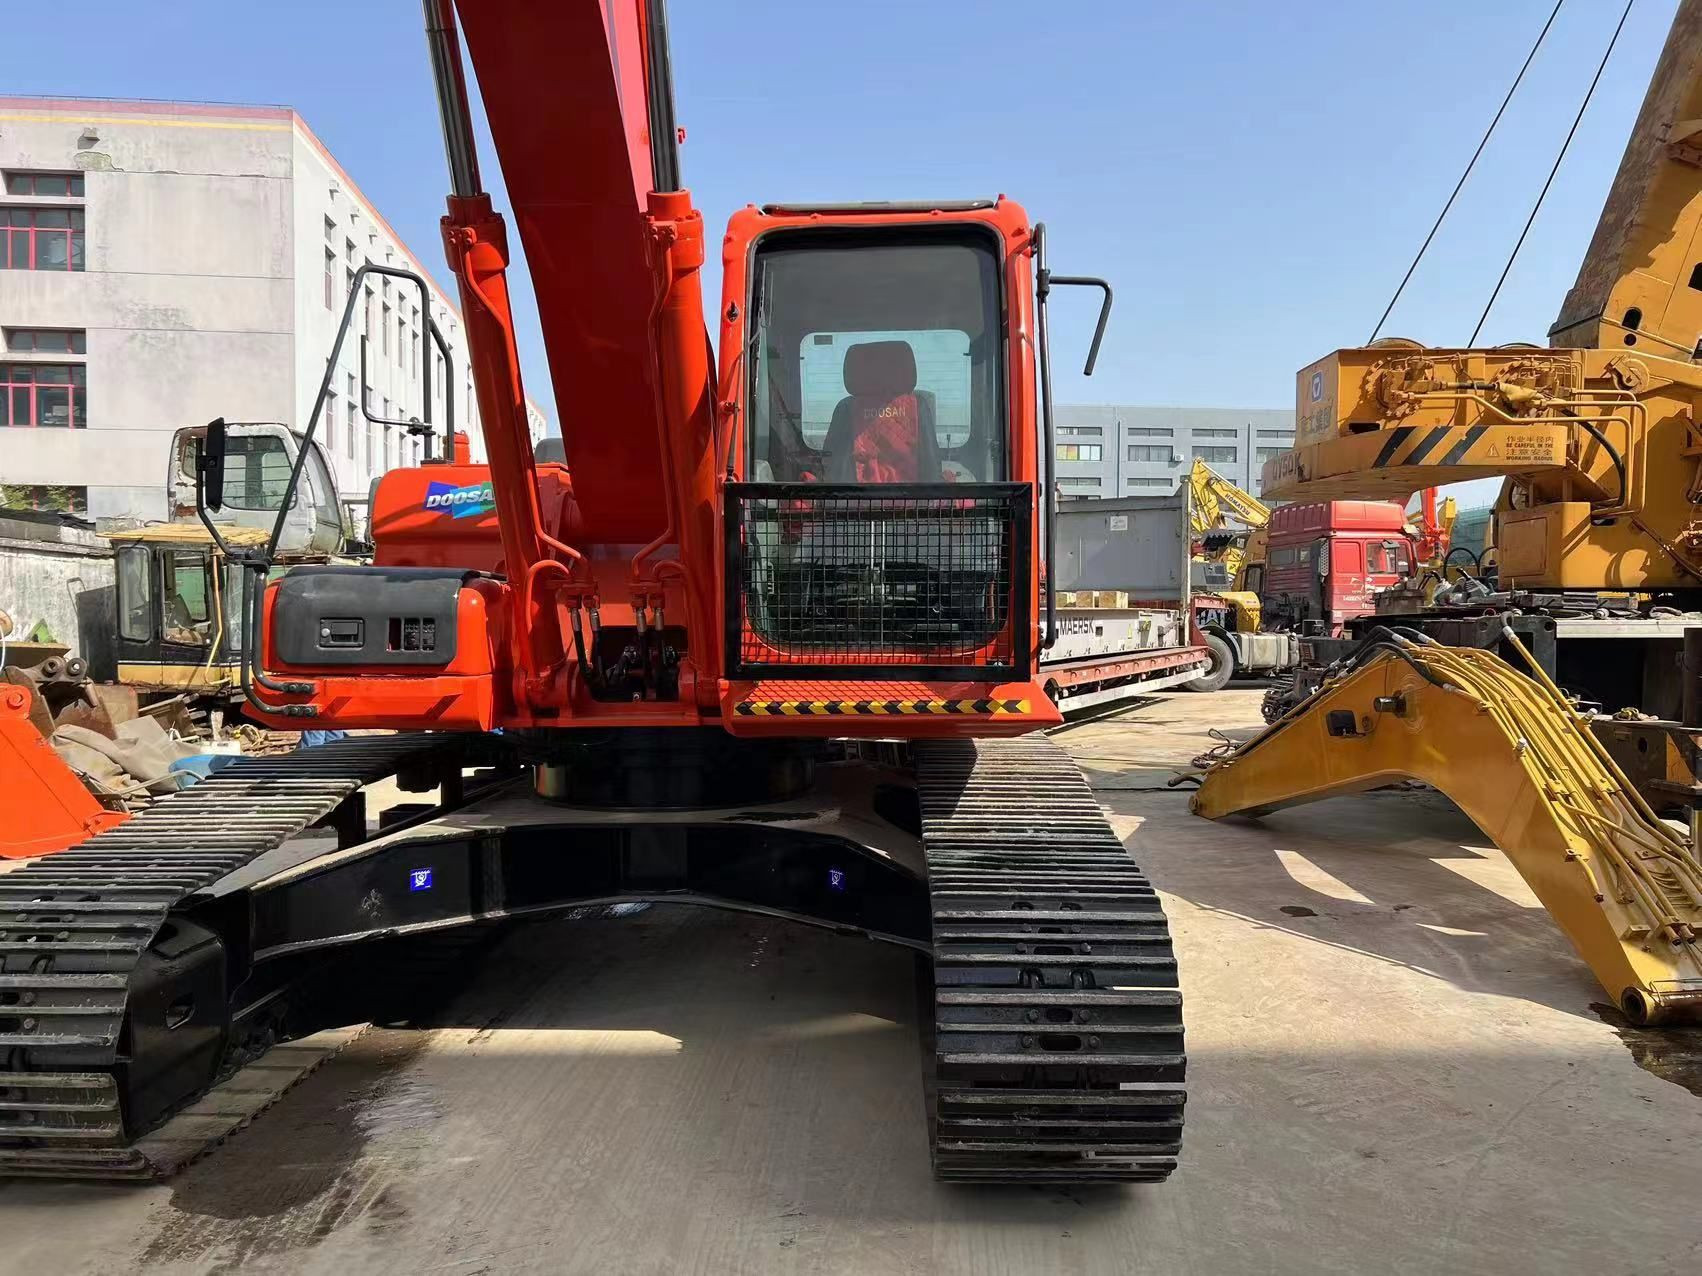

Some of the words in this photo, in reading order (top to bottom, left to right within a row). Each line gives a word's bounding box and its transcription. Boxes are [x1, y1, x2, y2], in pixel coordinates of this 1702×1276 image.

[864, 406, 906, 418] DOOSAN
[426, 489, 494, 507] DOOSA
[1225, 493, 1251, 516] KOMATSU
[1059, 616, 1095, 636] MAERSK
